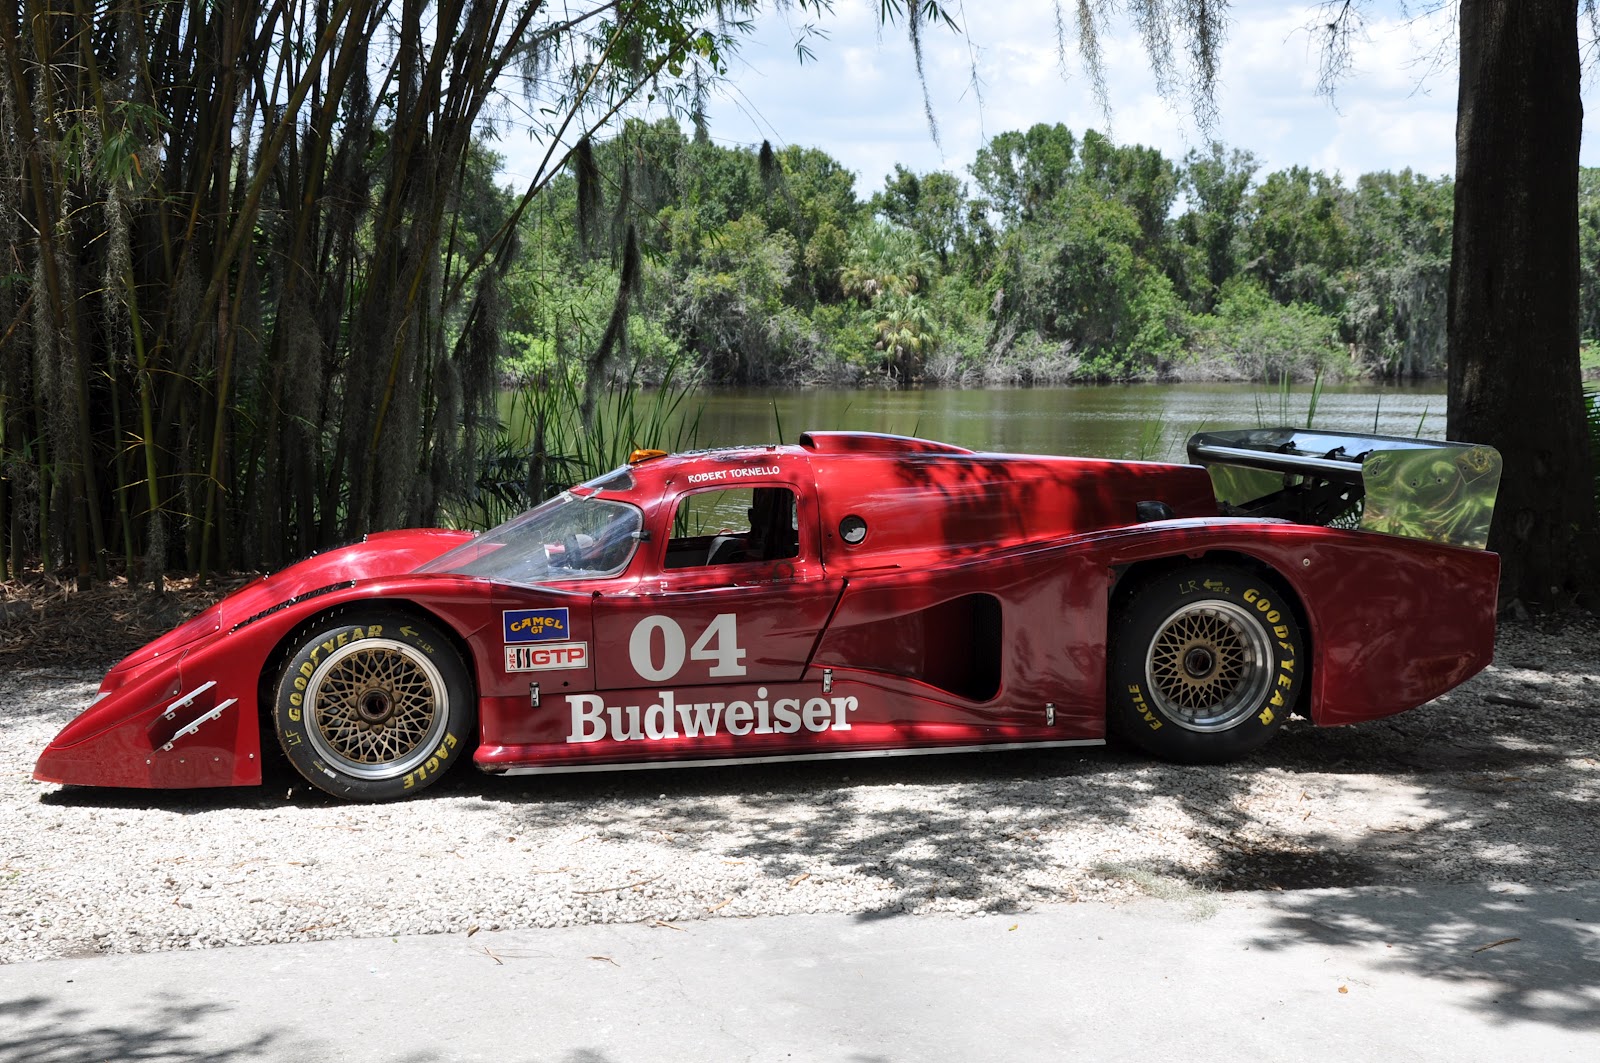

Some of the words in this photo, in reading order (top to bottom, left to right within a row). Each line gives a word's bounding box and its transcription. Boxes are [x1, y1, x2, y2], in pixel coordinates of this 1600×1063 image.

[688, 469, 727, 484] ROBERT
[729, 465, 780, 479] TORNELLO
[1179, 580, 1200, 595] LR
[510, 616, 563, 631] CAMEL
[530, 625, 544, 634] GT
[531, 648, 584, 665] GTP
[629, 613, 747, 682] 04
[1243, 588, 1295, 726] GOODYEAR
[508, 648, 516, 669] IMSA
[288, 624, 383, 722] GOODYEAR
[565, 687, 858, 743] Budweiser
[1128, 683, 1163, 731] EAGLE
[285, 729, 301, 746] LF
[403, 731, 458, 789] EAGLE
